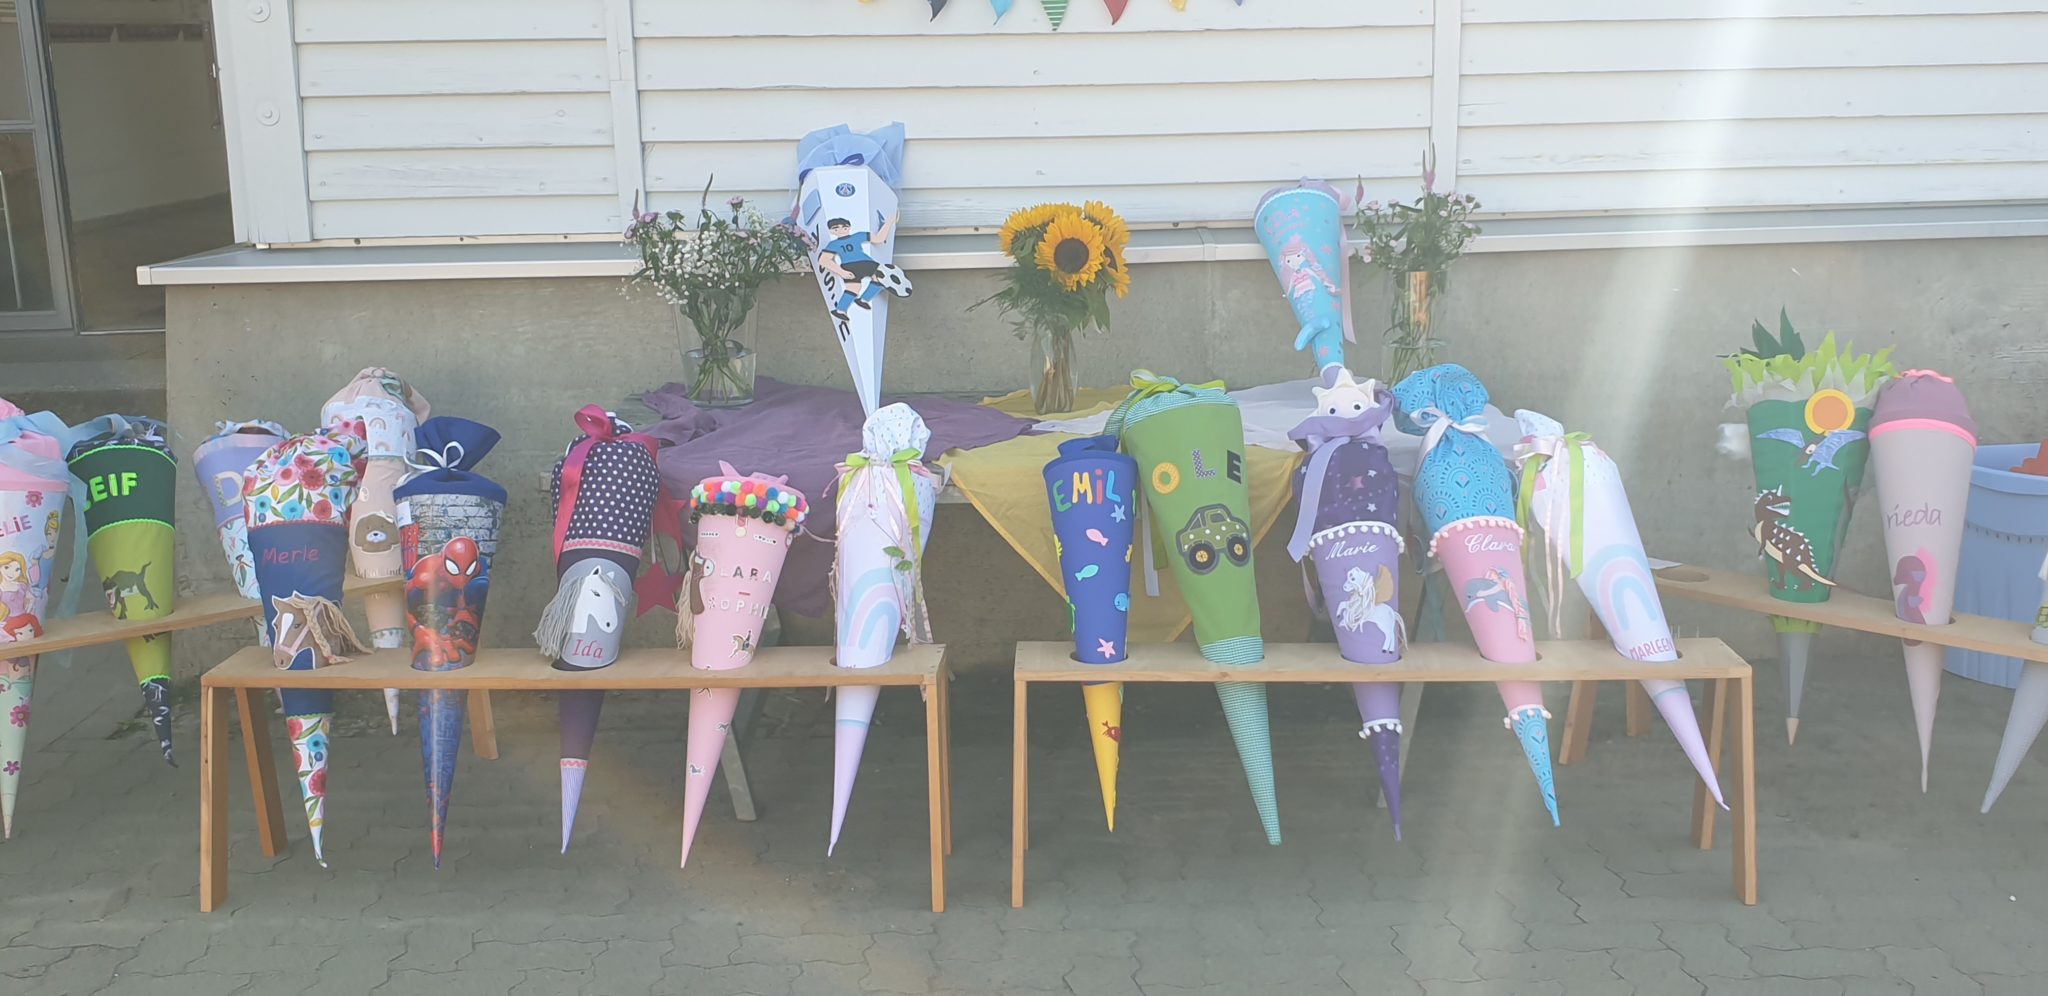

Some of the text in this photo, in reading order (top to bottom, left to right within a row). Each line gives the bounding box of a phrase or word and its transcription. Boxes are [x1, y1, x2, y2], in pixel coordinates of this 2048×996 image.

[840, 244, 854, 254] 10
[1152, 449, 1242, 485] OLE
[83, 471, 138, 512] EIF
[1325, 540, 1380, 560] Marie
[1464, 533, 1516, 553] Clara
[262, 544, 319, 566] Merle
[572, 639, 603, 659] Ida
